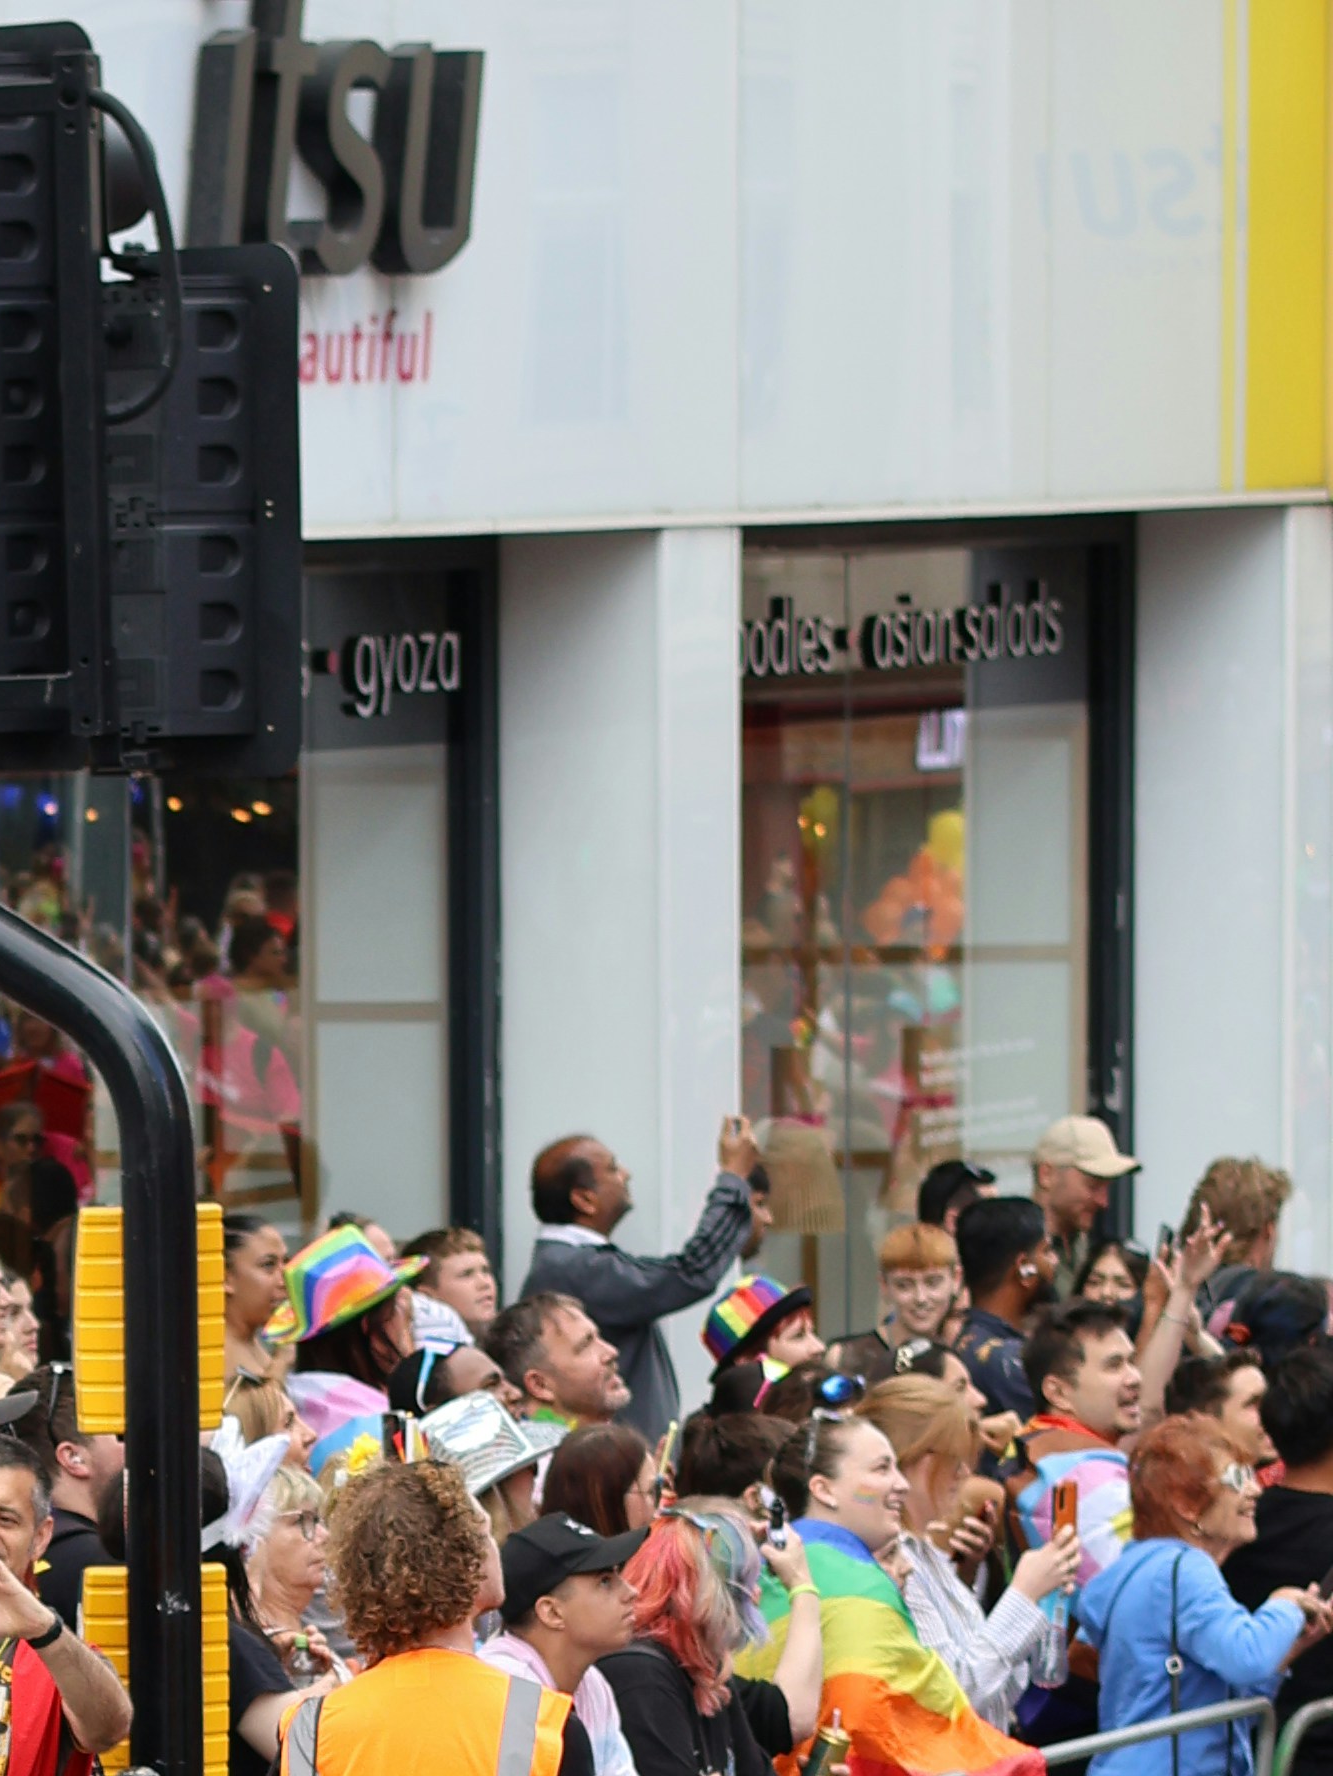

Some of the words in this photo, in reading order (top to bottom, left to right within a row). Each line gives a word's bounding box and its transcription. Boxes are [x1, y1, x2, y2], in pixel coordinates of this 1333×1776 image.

[298, 309, 434, 384] autiful
[964, 578, 1063, 662] salads
[354, 630, 461, 719] gyoza
